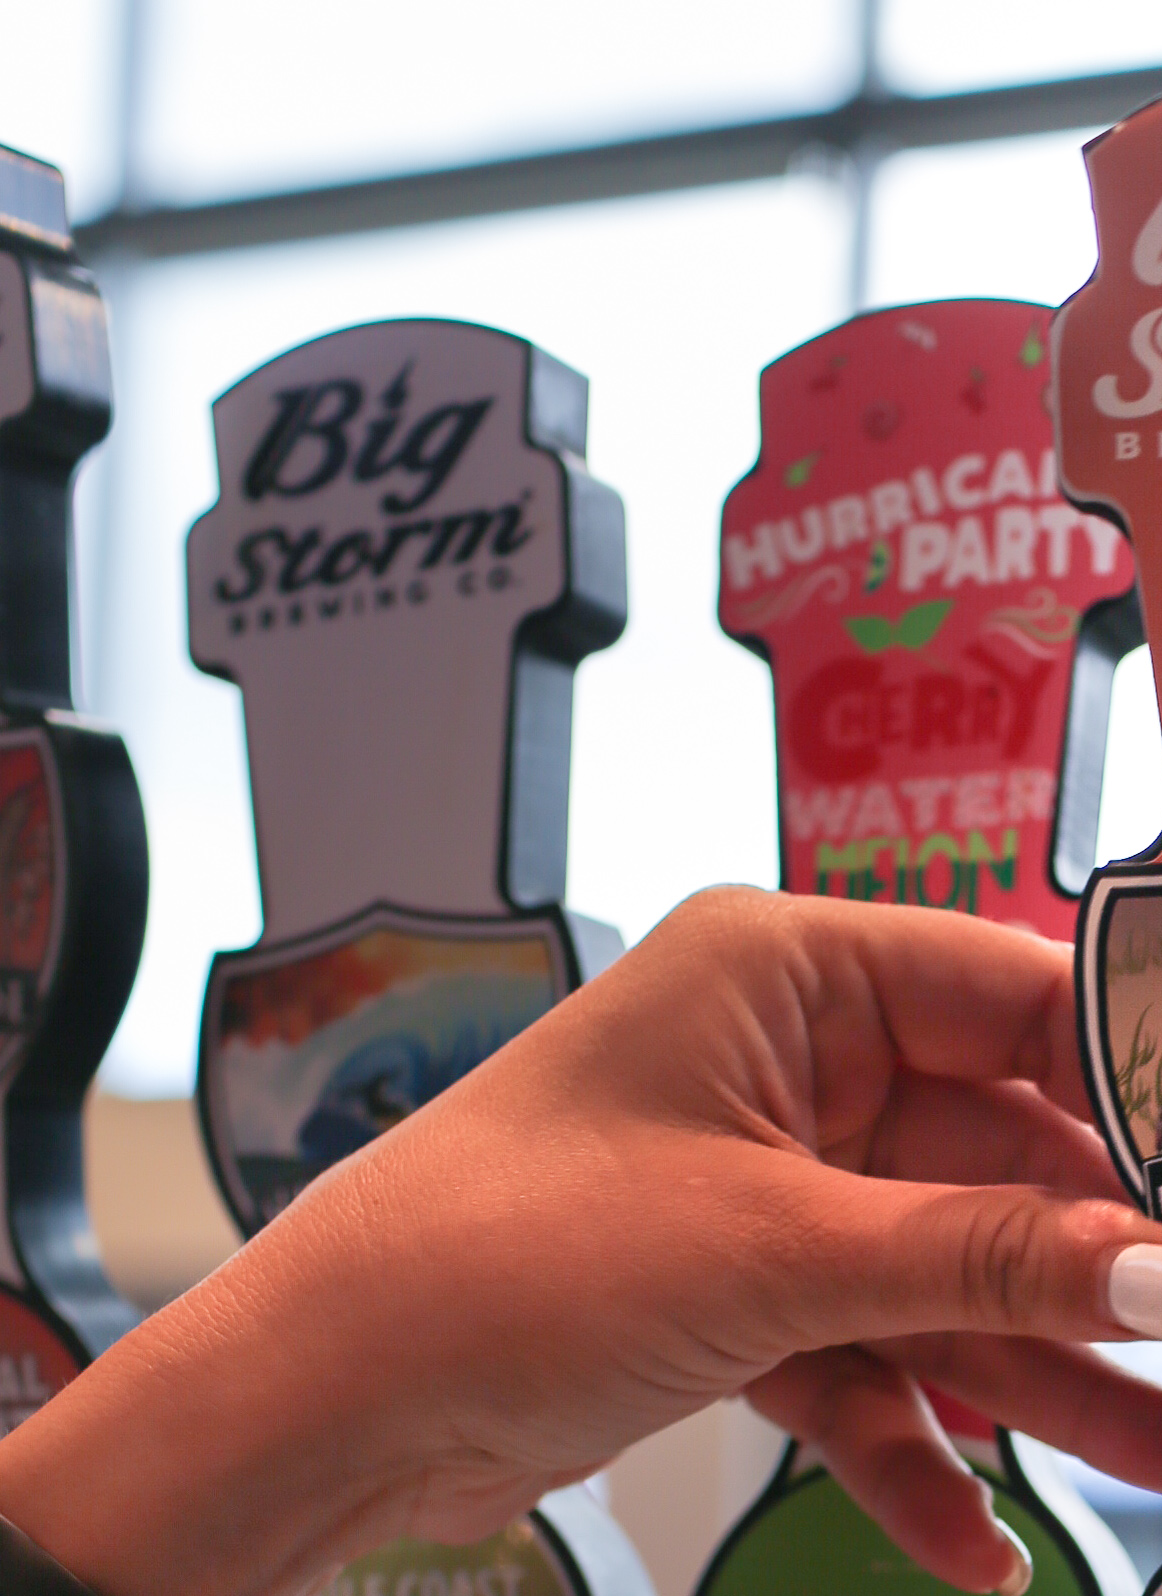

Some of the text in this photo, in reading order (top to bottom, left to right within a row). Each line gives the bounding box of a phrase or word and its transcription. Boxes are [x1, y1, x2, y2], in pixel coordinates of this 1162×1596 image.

[242, 353, 496, 514] Big
[214, 504, 533, 602] Storm
[725, 448, 1061, 591] HURRICA
[900, 507, 1122, 594] PARTY
[783, 769, 1057, 842] WATER
